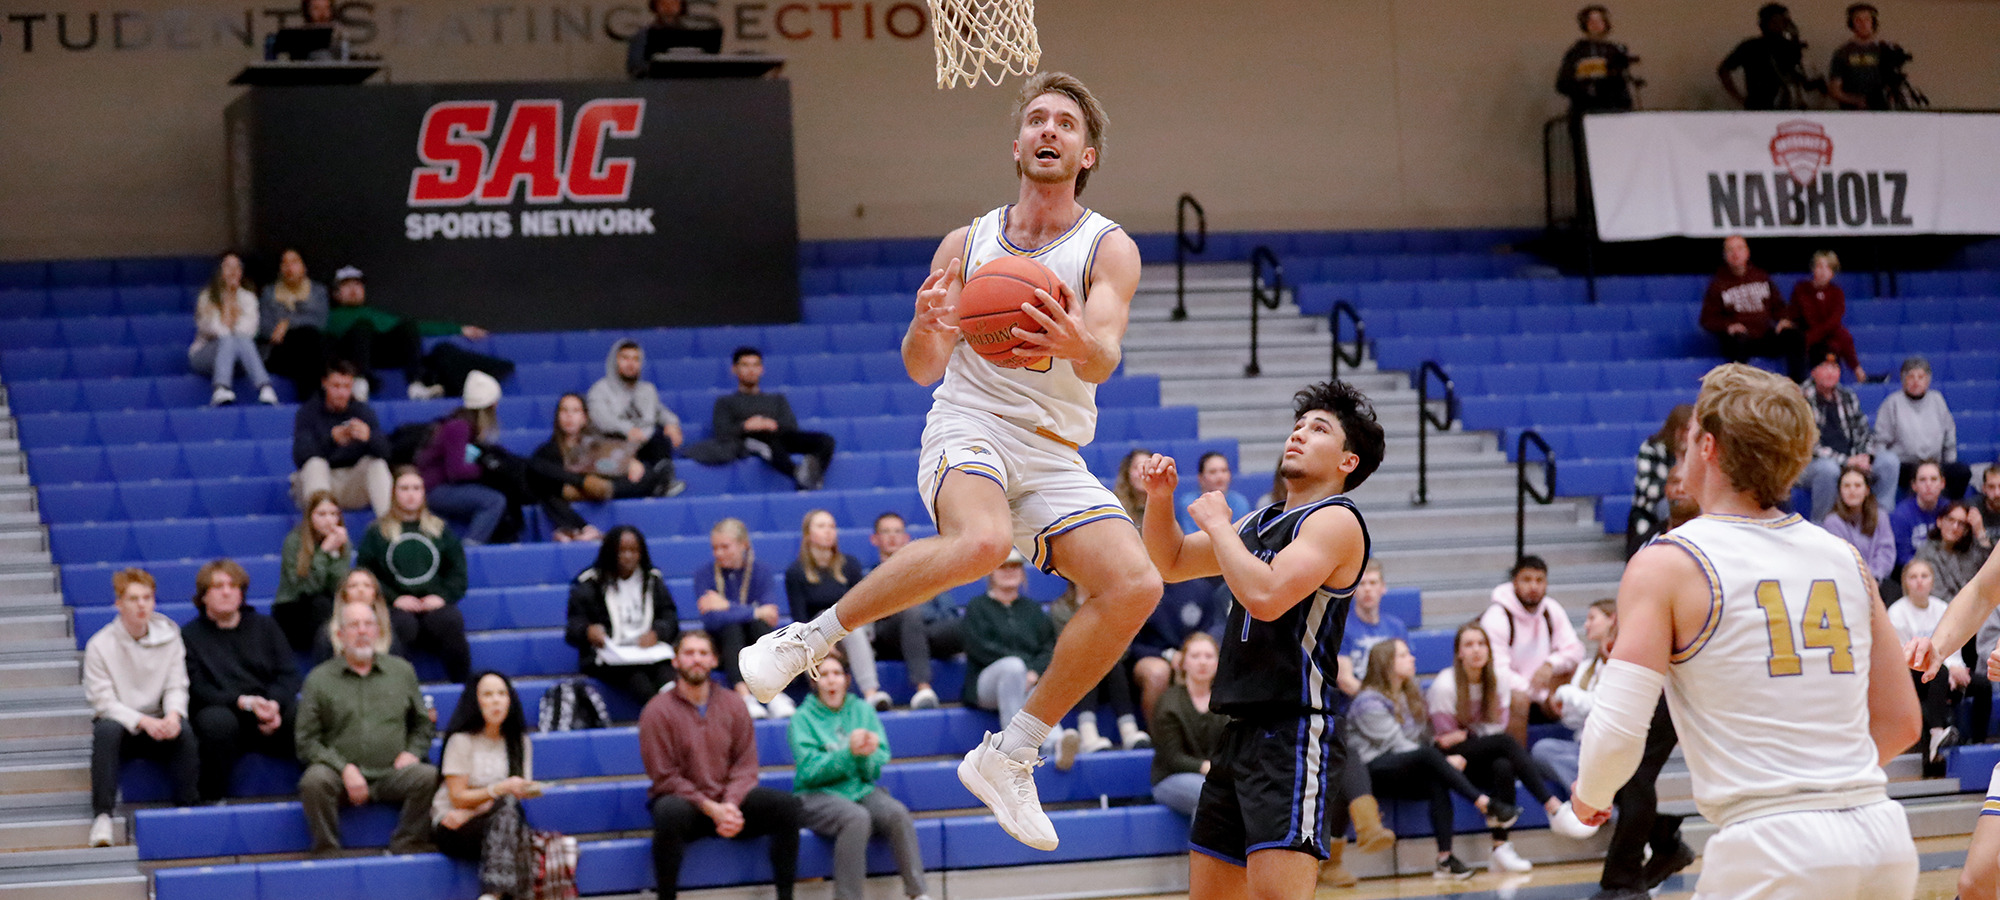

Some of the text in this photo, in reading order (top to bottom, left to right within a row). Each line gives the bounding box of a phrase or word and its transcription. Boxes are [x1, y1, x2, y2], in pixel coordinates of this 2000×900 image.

[407, 98, 646, 206] SAC
[405, 207, 656, 241] SPORTS NETWORK
[1708, 170, 1913, 227] NABHOLZ
[1755, 579, 1855, 677] 14
